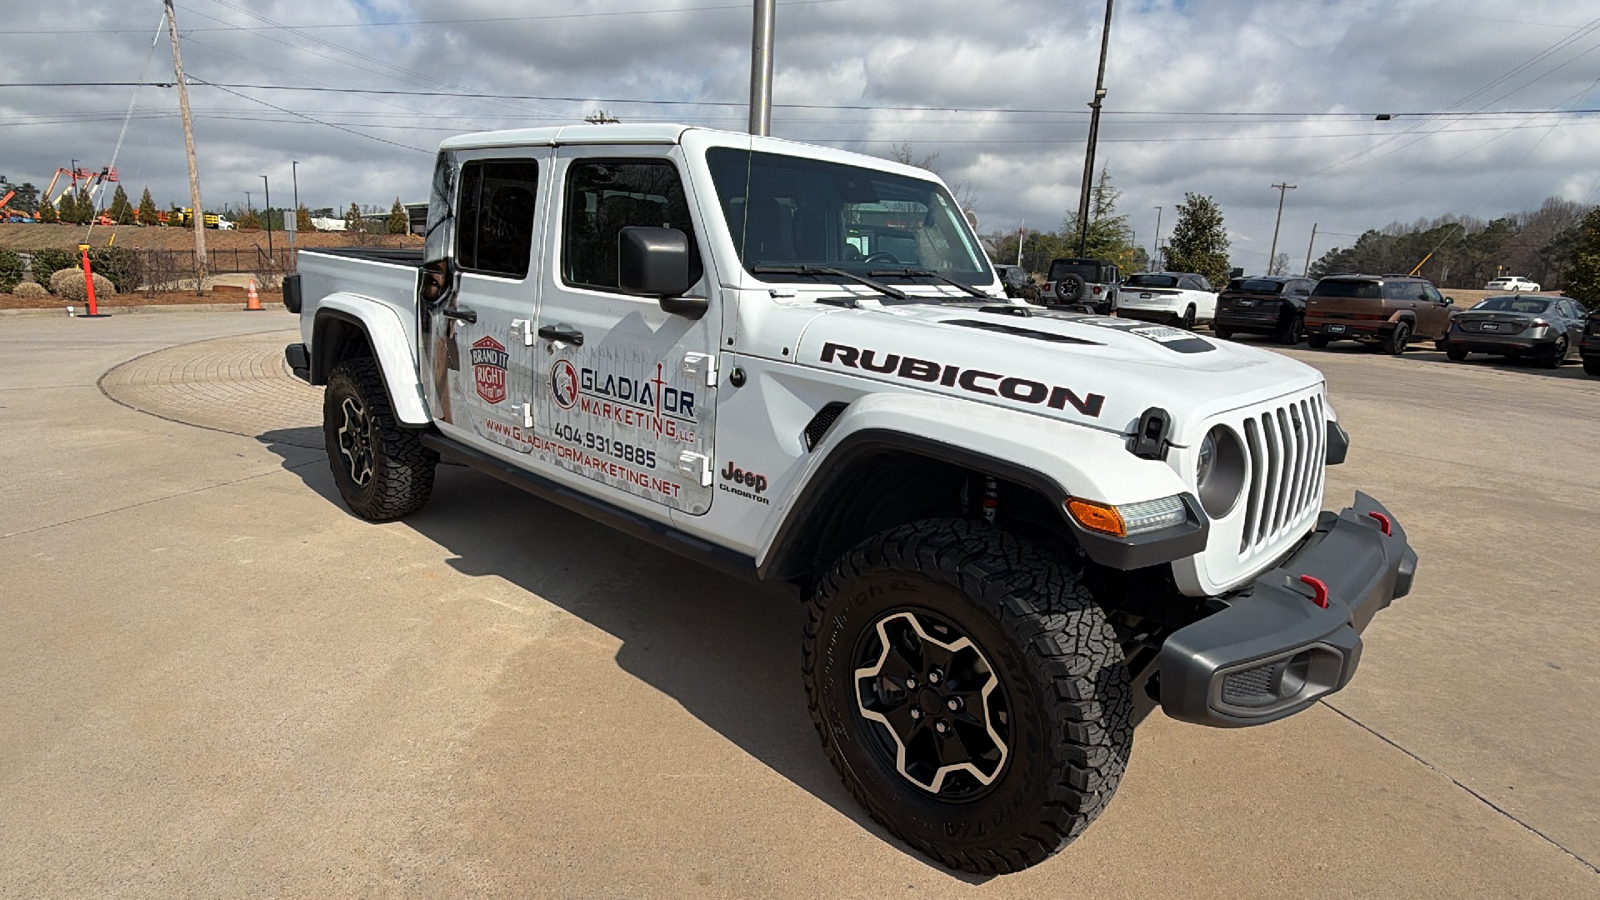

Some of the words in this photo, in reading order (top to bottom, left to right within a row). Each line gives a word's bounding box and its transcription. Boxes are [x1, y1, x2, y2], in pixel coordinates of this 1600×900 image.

[473, 350, 498, 364] BRAND
[499, 353, 507, 367] IT
[478, 367, 503, 385] RIGHT
[581, 362, 695, 417] GLADIATOR
[819, 342, 1106, 417] RUBICON
[485, 418, 681, 498] WWW.GLADIATORMARKETING.NET
[554, 422, 657, 469] 404.931.9885
[719, 483, 770, 505] GLADIATOR
[721, 461, 768, 493] Jeep
